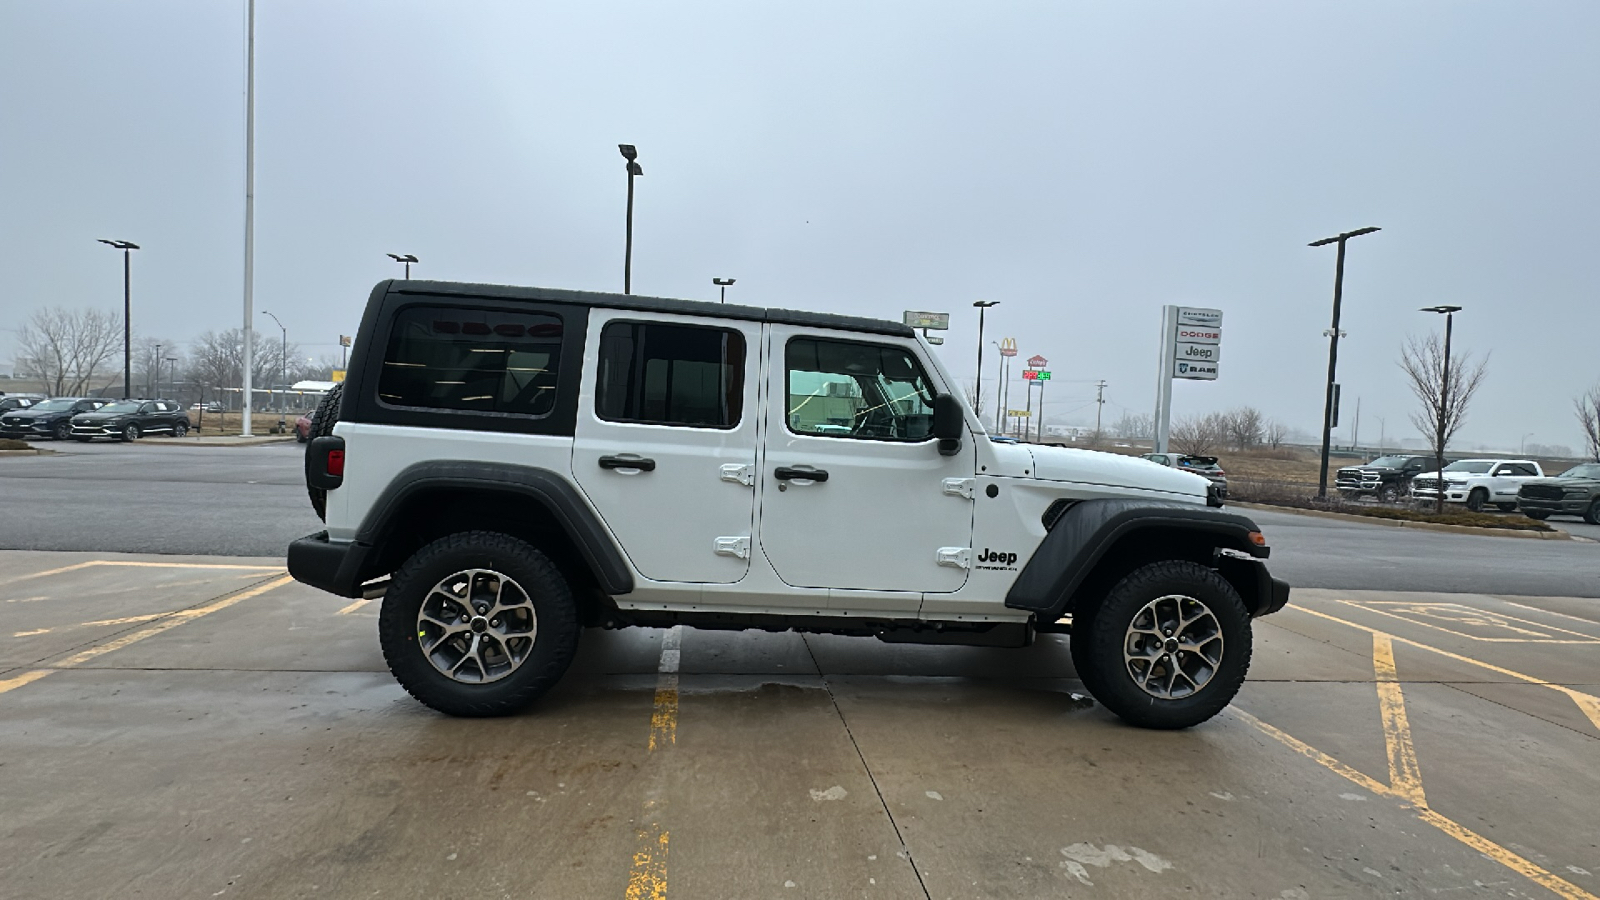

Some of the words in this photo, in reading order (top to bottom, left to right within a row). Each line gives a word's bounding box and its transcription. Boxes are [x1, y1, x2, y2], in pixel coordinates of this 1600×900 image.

[1181, 331, 1219, 339] DODGE
[1186, 346, 1212, 358] Jeep
[1190, 366, 1216, 374] RAM
[978, 548, 1017, 566] Jeep
